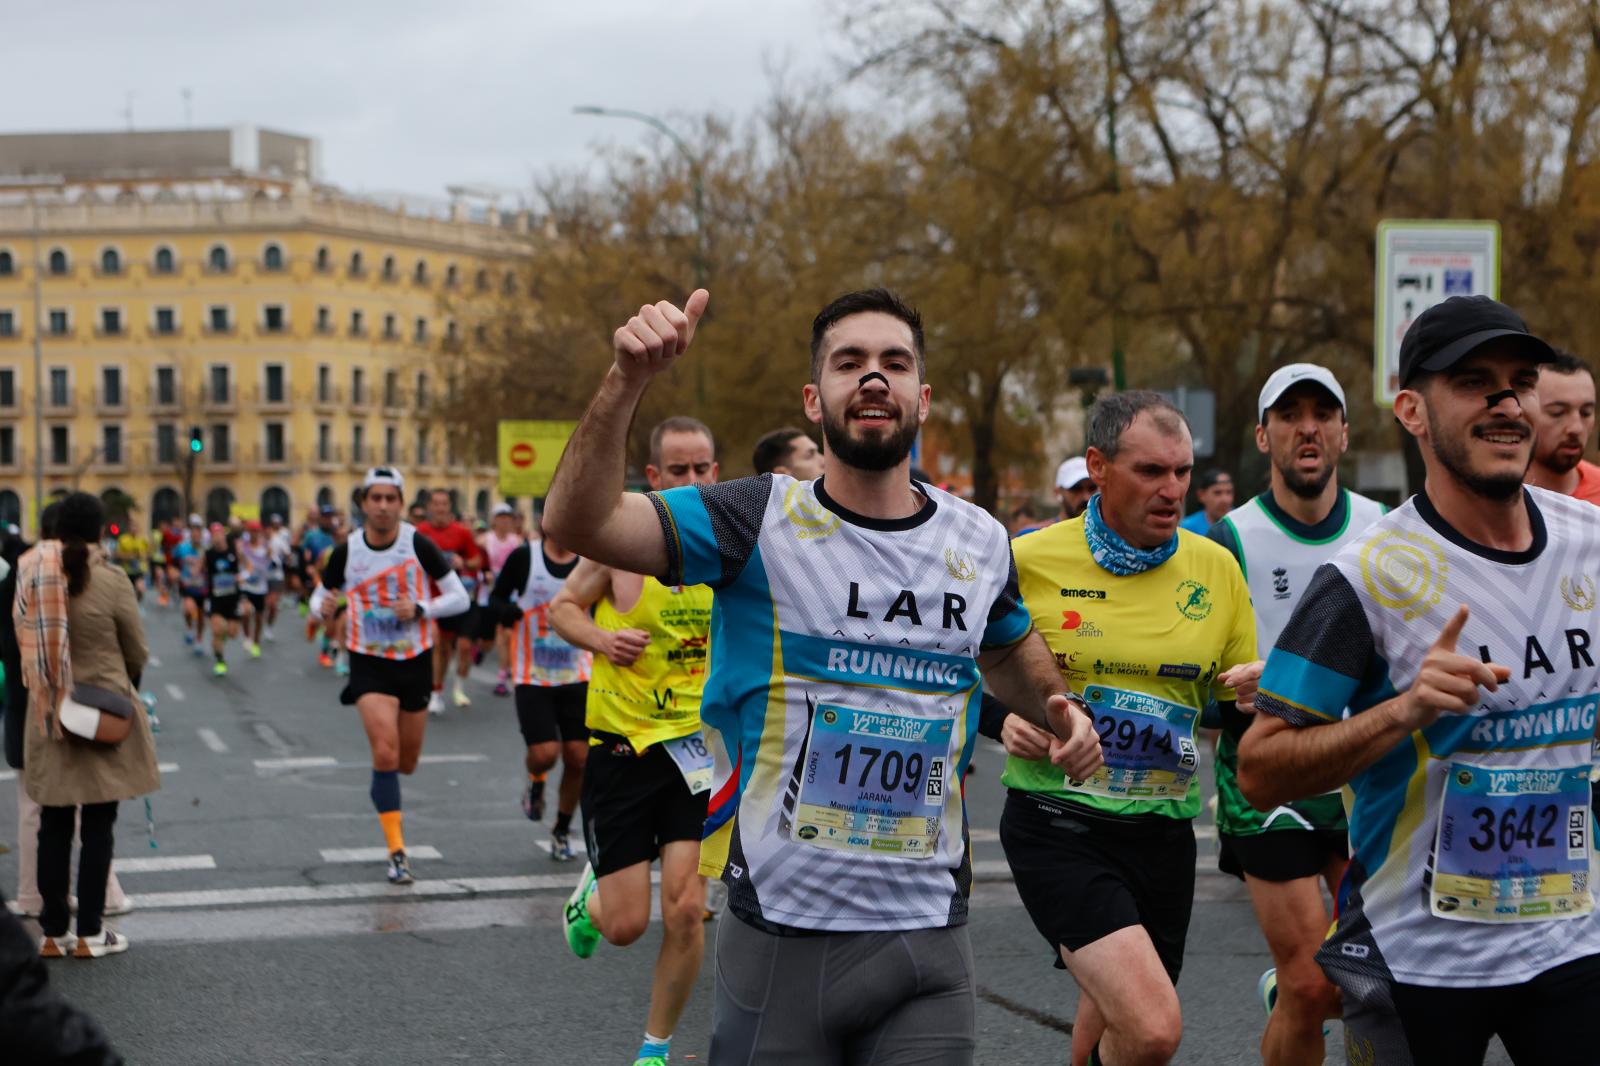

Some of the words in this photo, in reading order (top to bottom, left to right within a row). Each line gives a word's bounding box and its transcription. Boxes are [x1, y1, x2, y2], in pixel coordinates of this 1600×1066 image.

[847, 582, 968, 632] LAR
[1076, 628, 1103, 638] Smith
[1082, 621, 1095, 630] DS
[832, 629, 971, 655] AYALA
[827, 648, 962, 686] RUNNING
[1109, 661, 1147, 669] BODEGAS
[1117, 668, 1150, 677] MONTE
[868, 714, 921, 730] maratón
[880, 725, 921, 740] sevilla
[1099, 716, 1173, 756] 2914
[681, 738, 708, 760] 18
[834, 743, 924, 794] 1709
[857, 790, 893, 804] JARANA
[829, 800, 858, 812] Manuel
[860, 805, 885, 817] Jarana
[1468, 804, 1558, 852] 3642
